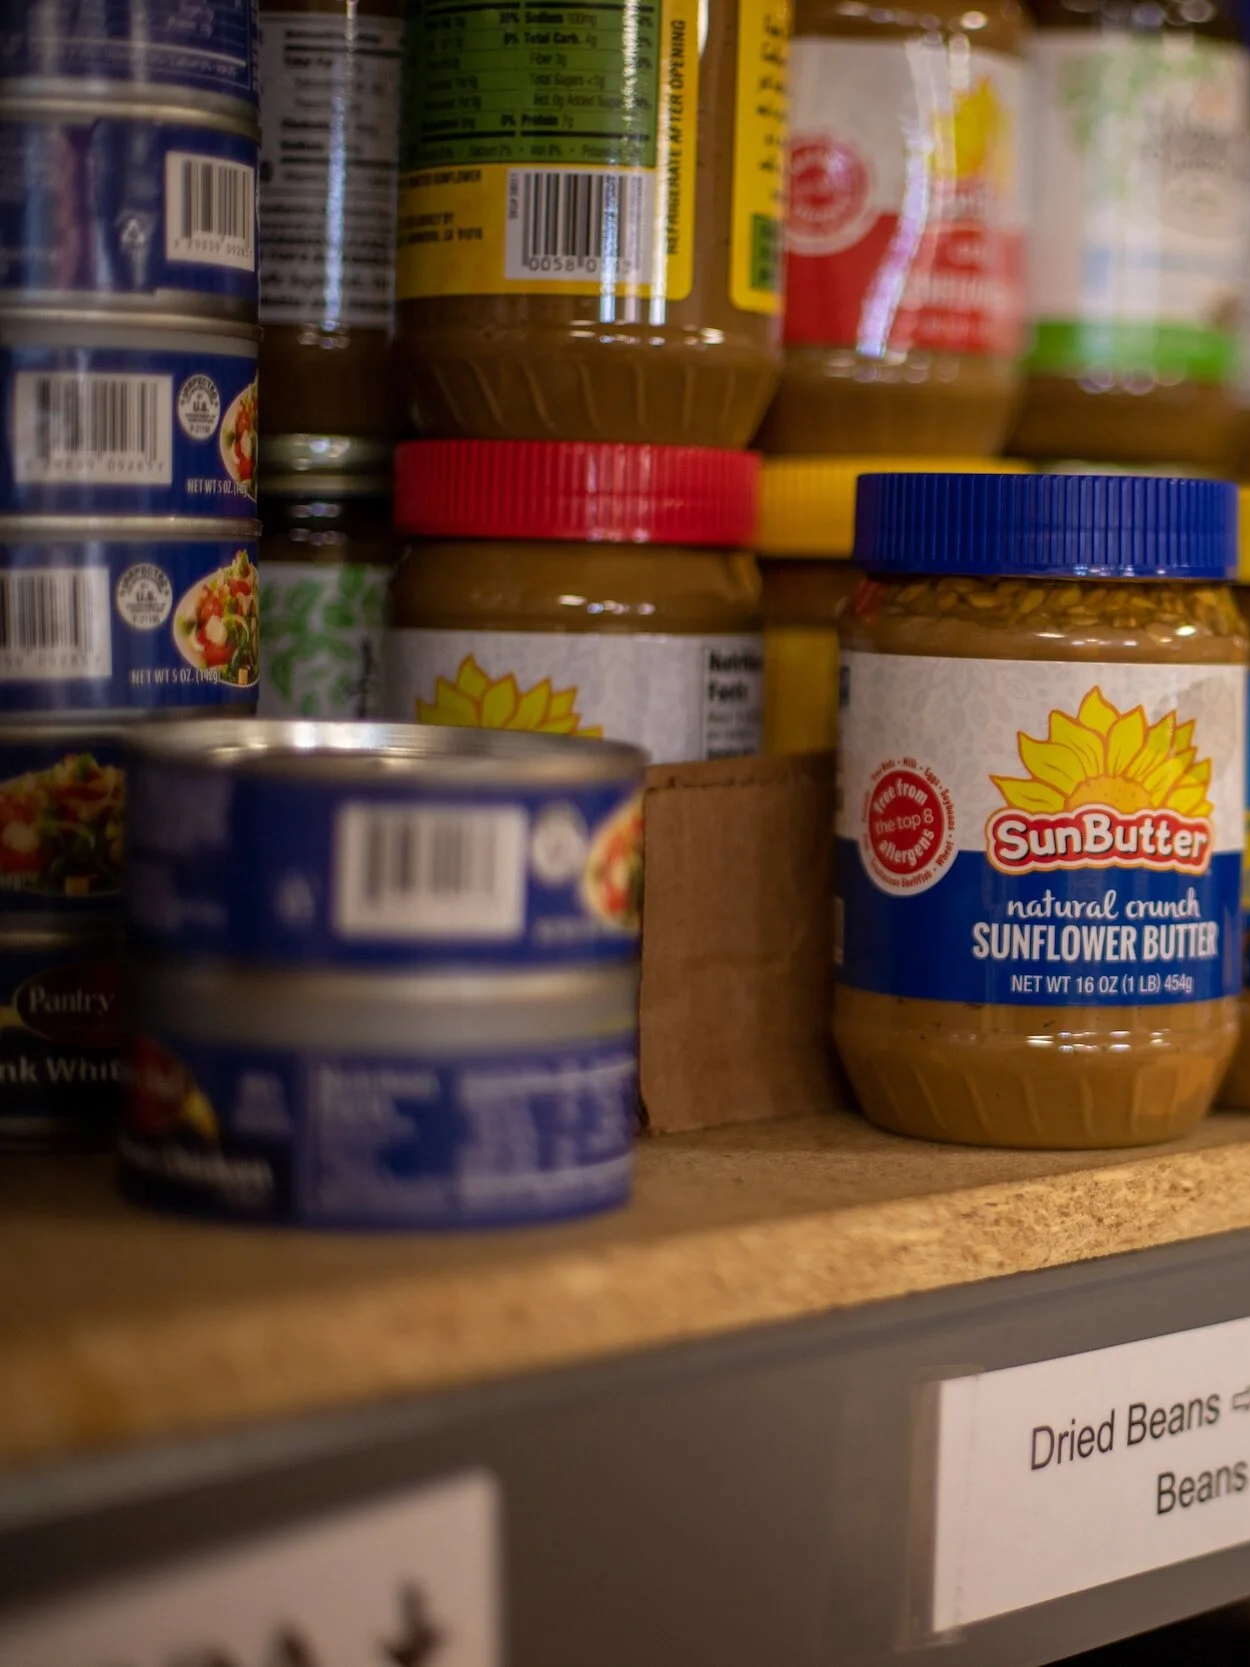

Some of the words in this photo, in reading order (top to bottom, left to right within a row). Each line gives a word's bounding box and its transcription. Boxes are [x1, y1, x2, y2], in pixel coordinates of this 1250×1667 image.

[669, 19, 687, 89] OPENING
[668, 94, 684, 145] AFTER
[528, 257, 576, 273] 0058
[186, 478, 203, 495] NET
[204, 478, 217, 495] WT
[217, 479, 223, 494] 5
[130, 668, 152, 686] NET
[154, 668, 171, 685] WT
[172, 668, 178, 683] 5
[179, 668, 195, 684] OZ.
[924, 767, 941, 786] Eggs
[873, 786, 896, 815] free
[895, 778, 929, 806] from
[940, 788, 955, 831] Soybeans
[875, 818, 896, 835] the
[897, 814, 922, 832] top
[923, 807, 934, 824] 8
[999, 812, 1208, 861] SunButter
[879, 828, 935, 867] allergens
[935, 840, 955, 868] Wheat
[1006, 889, 1119, 920] natural
[1124, 887, 1202, 919] crunch
[971, 921, 1137, 962] SUNFLOWER
[1142, 920, 1219, 961] BUTTER
[27, 984, 117, 1018] Pantry
[1010, 974, 1043, 994] NET
[1046, 974, 1070, 994] WT
[1075, 975, 1095, 995] 16
[1098, 974, 1119, 994] OZ
[1122, 973, 1135, 996] (1
[1139, 973, 1161, 995] LB)
[1164, 974, 1193, 995] 454g
[46, 1053, 123, 1085] Whit
[1029, 1409, 1116, 1472] Dried
[1126, 1389, 1222, 1446] Beans
[1155, 1459, 1248, 1516] Beans
